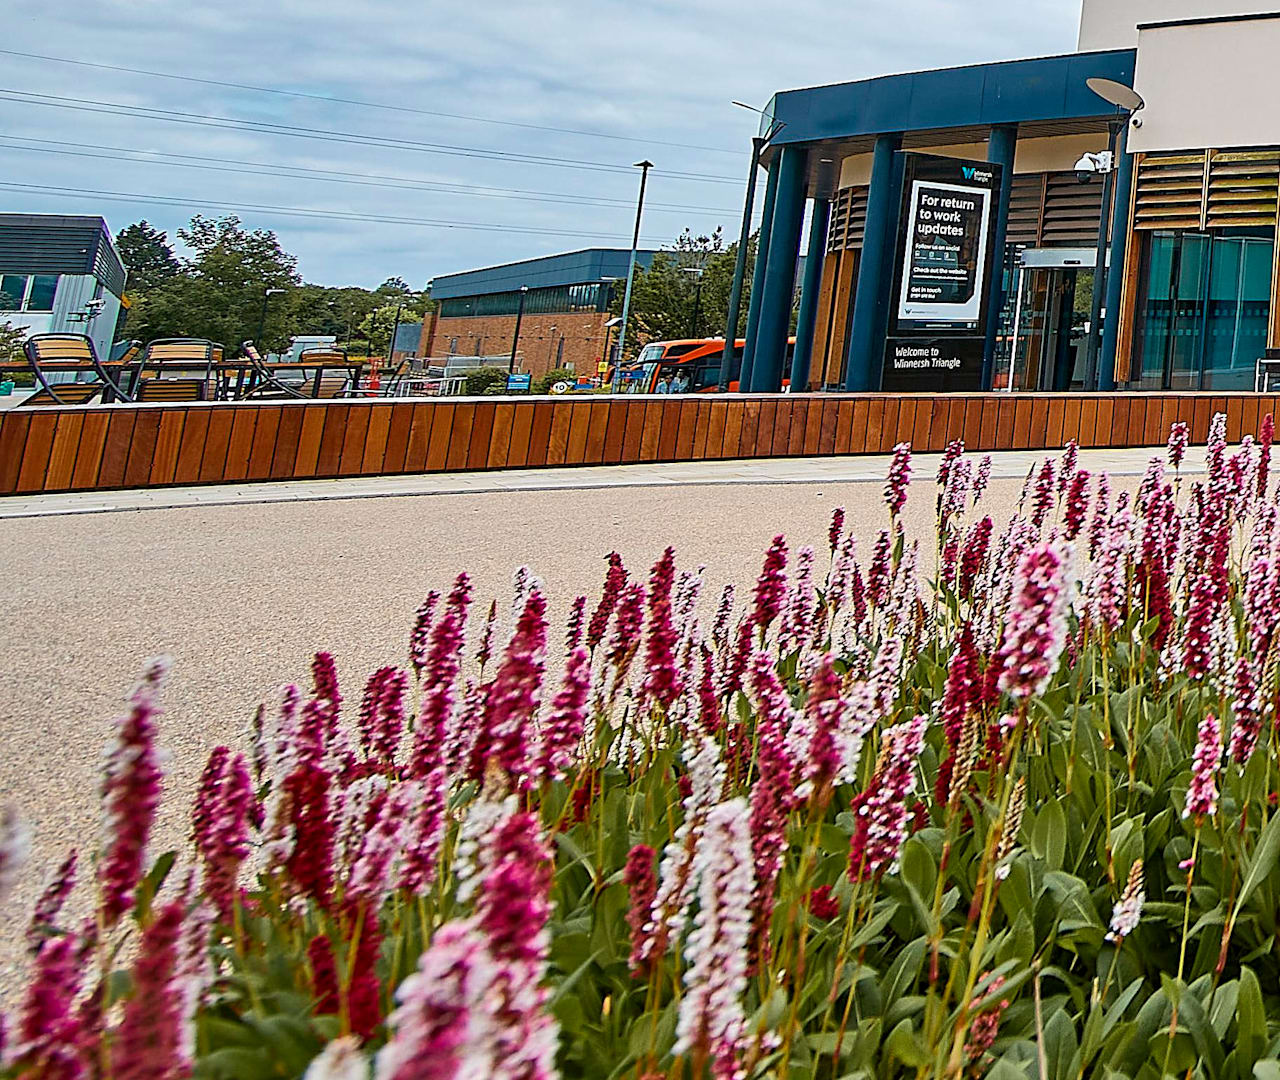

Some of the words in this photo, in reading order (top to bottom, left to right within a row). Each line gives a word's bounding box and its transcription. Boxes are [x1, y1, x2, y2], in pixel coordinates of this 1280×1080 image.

[921, 194, 939, 207] For
[940, 197, 975, 210] return
[919, 208, 932, 220] to
[933, 211, 961, 222] work
[917, 223, 964, 236] updates
[895, 347, 930, 357] Welcome
[930, 347, 940, 357] to
[893, 358, 930, 369] Winnersh
[931, 357, 961, 370] Triangle
